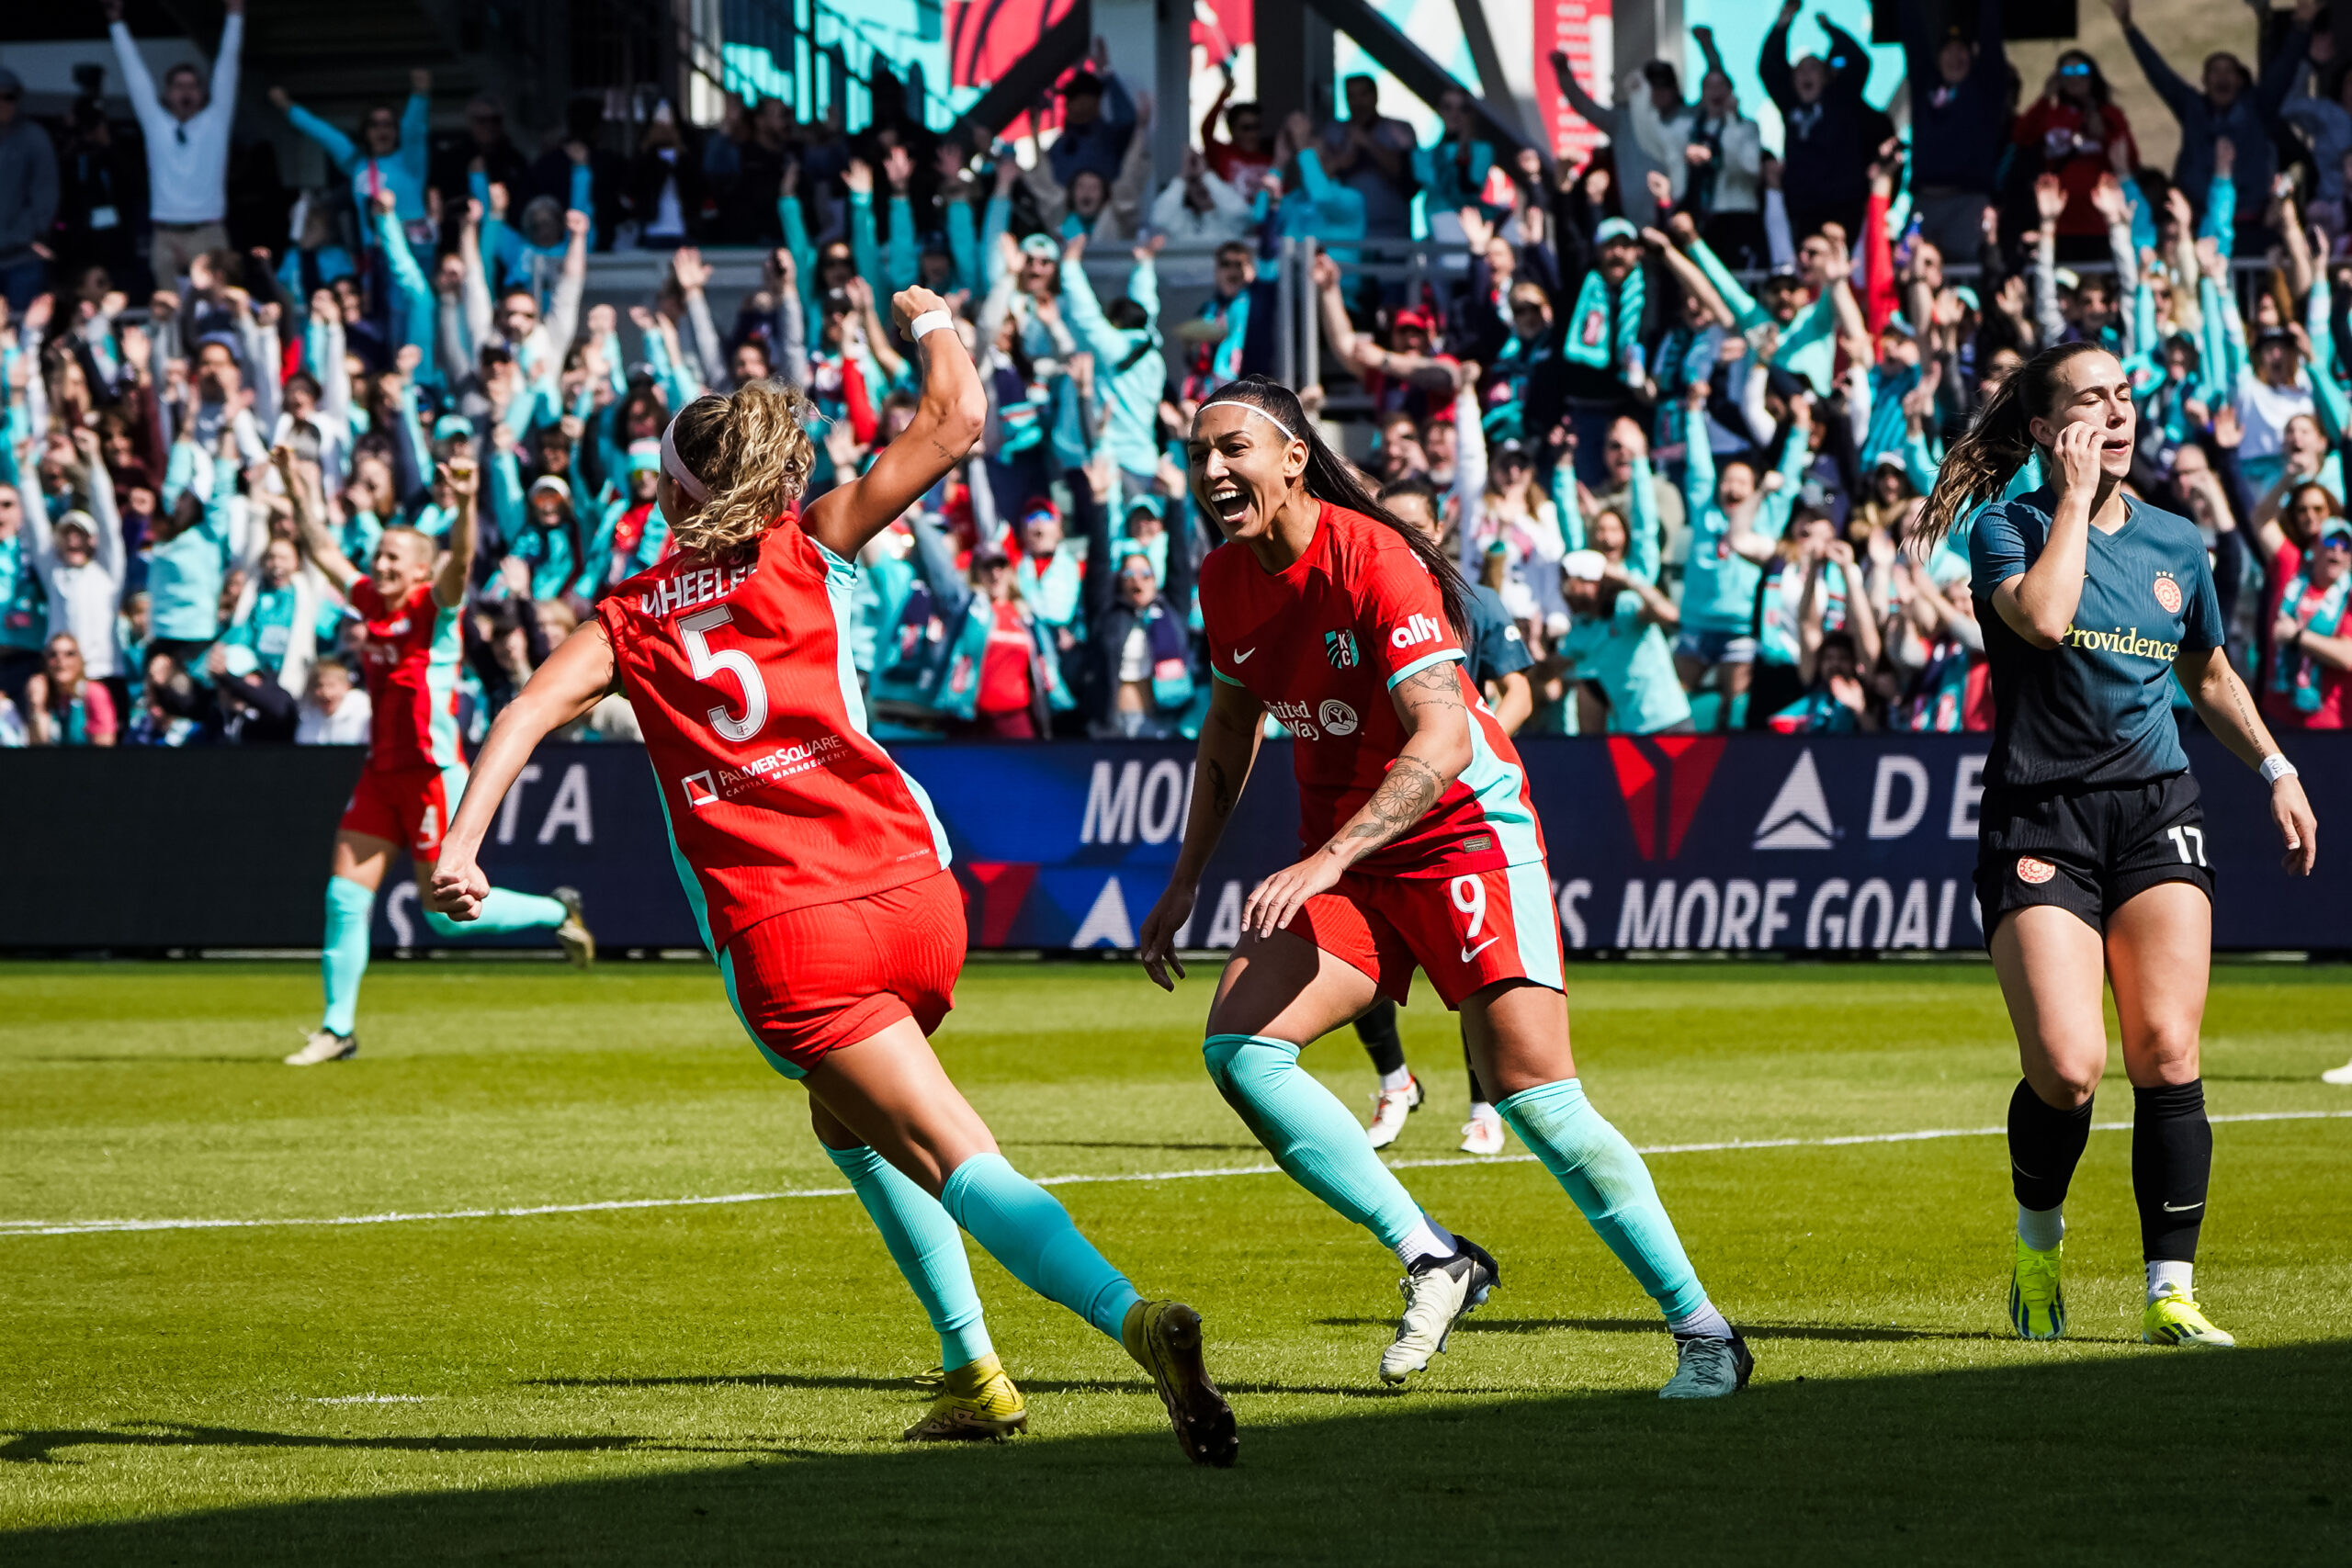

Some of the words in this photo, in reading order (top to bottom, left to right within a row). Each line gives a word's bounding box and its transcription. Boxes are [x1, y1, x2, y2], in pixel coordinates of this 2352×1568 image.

[1391, 613, 1442, 649] ally
[676, 603, 768, 742] 5
[1284, 719, 1319, 741] Way
[726, 778, 769, 797] CAPITAL
[772, 749, 848, 781] MANAGEMENT
[1080, 759, 1196, 844] MO
[2167, 826, 2207, 867] 17
[1450, 874, 1487, 939] 9
[1804, 878, 1984, 949] GOAL
